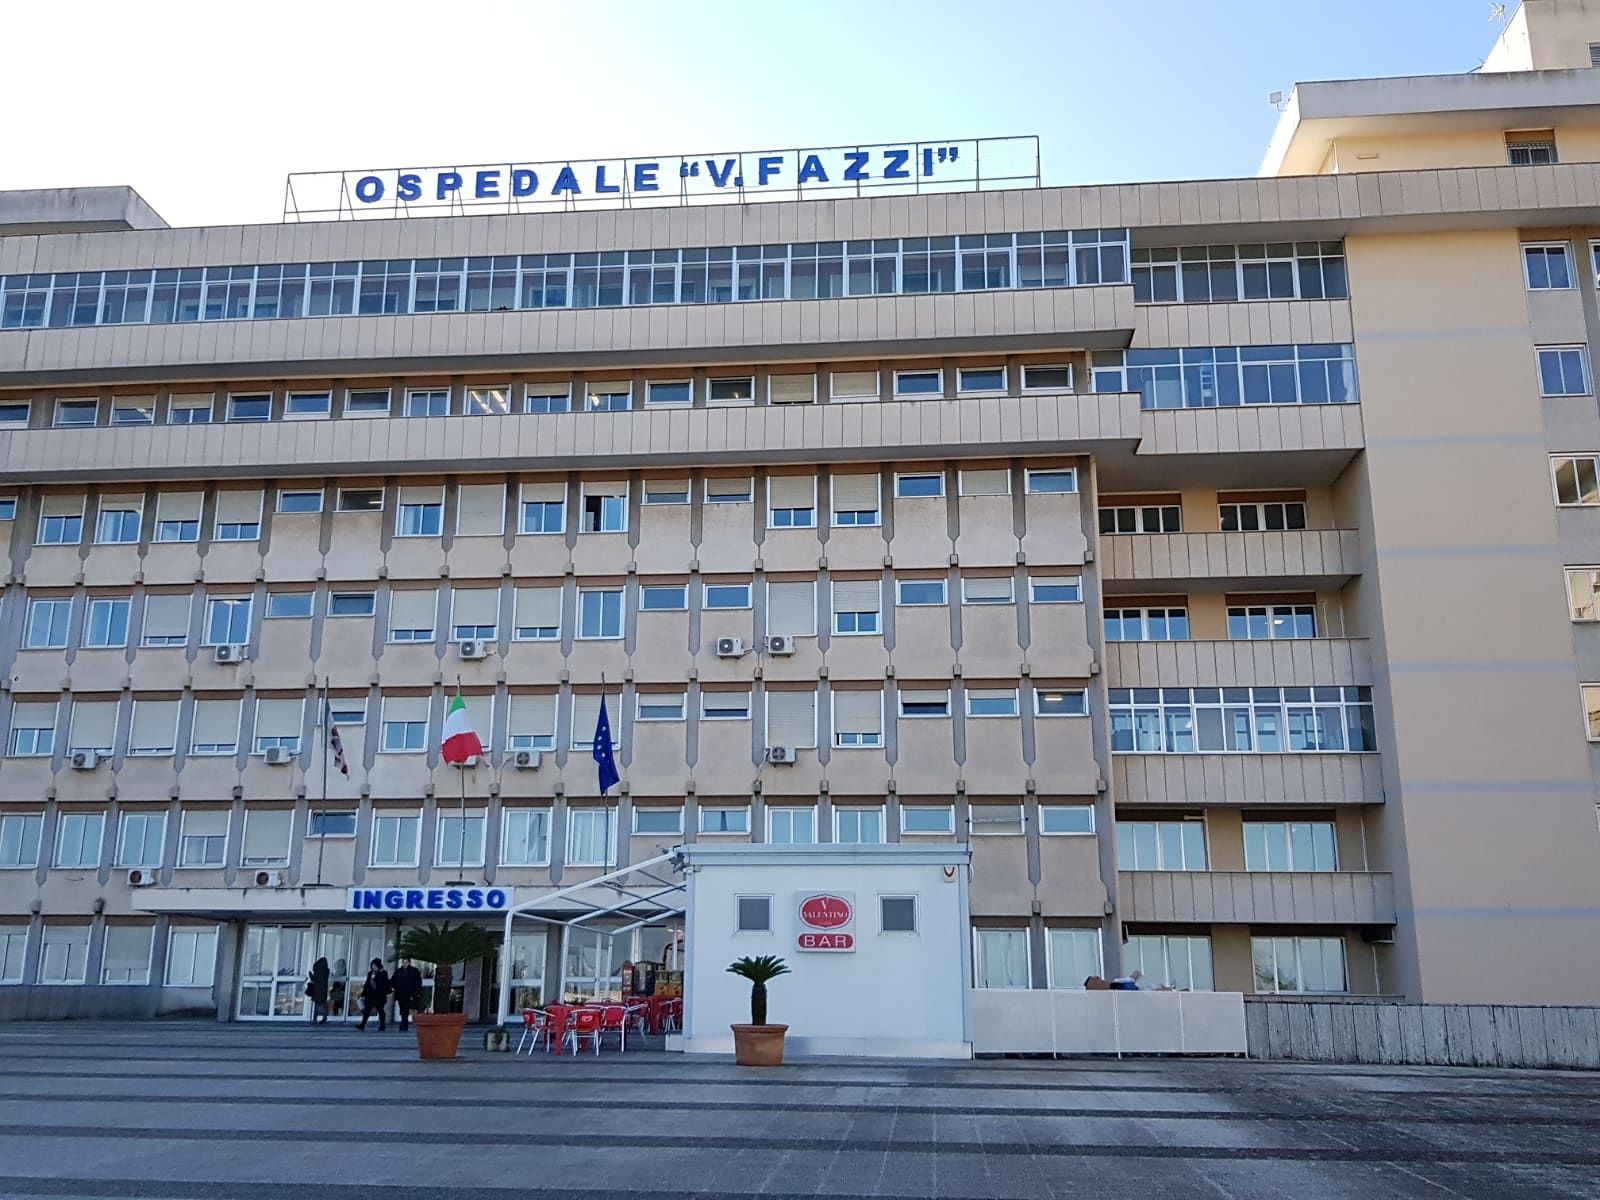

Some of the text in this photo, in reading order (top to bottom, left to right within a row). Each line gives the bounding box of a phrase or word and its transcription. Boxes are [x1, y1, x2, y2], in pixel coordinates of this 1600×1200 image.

[355, 163, 660, 203] OSPEDALE
[353, 889, 505, 909] INGRESSO
[804, 935, 847, 947] BAR
